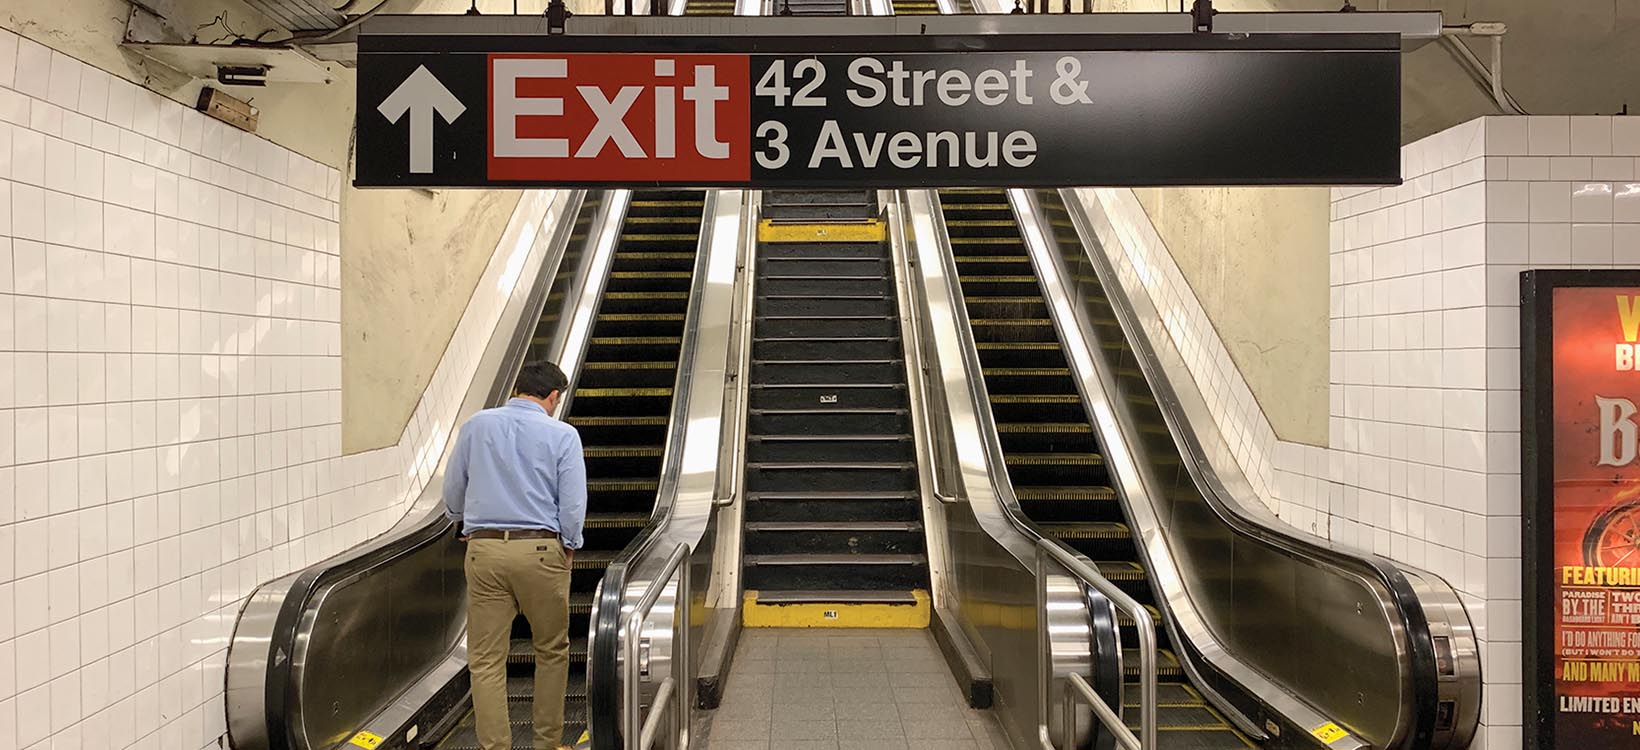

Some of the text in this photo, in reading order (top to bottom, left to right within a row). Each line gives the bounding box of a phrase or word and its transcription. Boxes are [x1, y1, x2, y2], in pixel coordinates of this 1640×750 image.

[755, 56, 1094, 107] 42 Street &
[493, 58, 730, 159] Exit
[755, 120, 1038, 169] 3 Avenue
[1562, 566, 1640, 585] FEATURI
[1562, 591, 1605, 599] PARADISE
[1562, 599, 1605, 616] BY THE
[1575, 631, 1586, 647] DO
[1588, 631, 1626, 648] ANYTHING
[1563, 662, 1587, 681] AND
[1590, 662, 1625, 682] MANY
[1560, 696, 1620, 713] LIMITED
